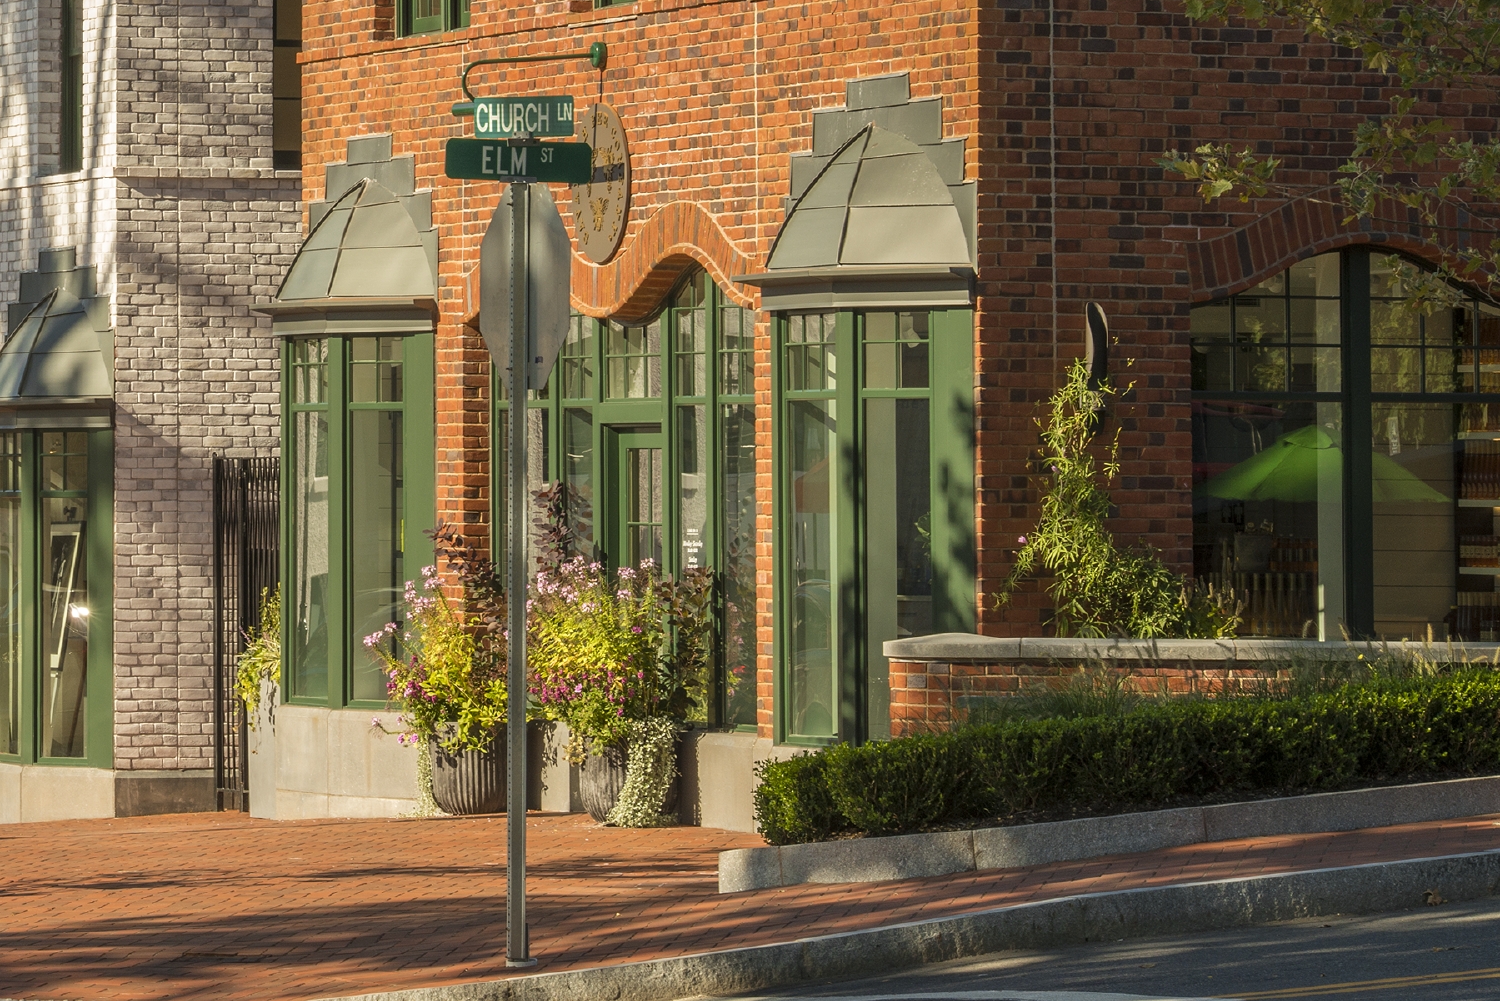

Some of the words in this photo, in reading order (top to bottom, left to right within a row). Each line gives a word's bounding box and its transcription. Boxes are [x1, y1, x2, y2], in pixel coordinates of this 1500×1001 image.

[476, 103, 549, 133] CHURCH
[557, 102, 572, 121] LN
[481, 145, 527, 175] ELM
[540, 148, 554, 163] ST
